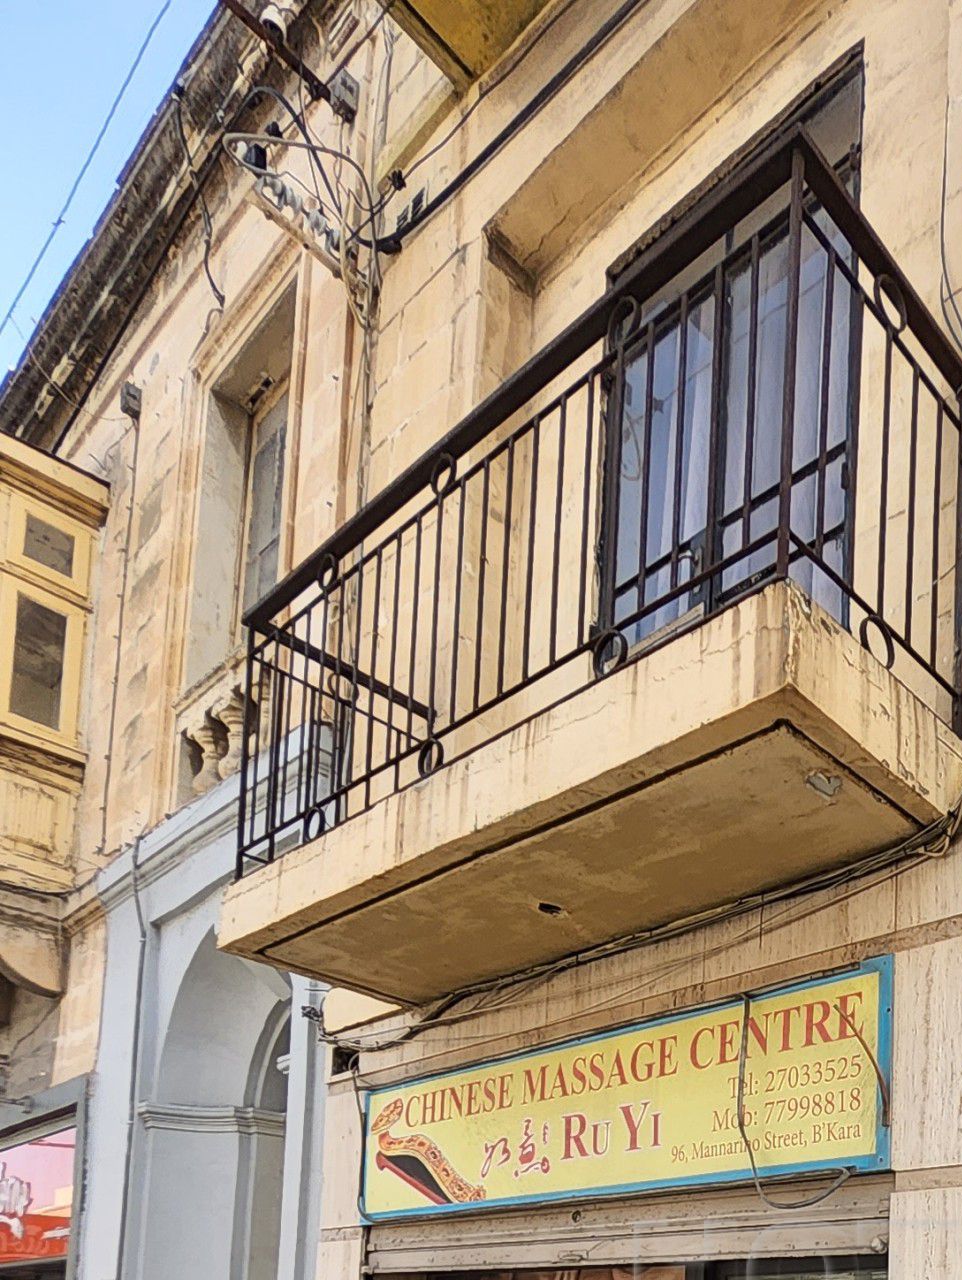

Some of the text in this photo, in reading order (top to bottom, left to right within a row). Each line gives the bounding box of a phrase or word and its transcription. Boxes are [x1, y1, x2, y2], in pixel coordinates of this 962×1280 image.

[404, 991, 865, 1128] CHINESE MASSAGE CENTRE
[727, 1054, 862, 1099] Tel: 27033525
[712, 1087, 862, 1133] Mob: 77998818
[671, 1145, 688, 1164] 96,
[764, 1129, 808, 1150] Street,
